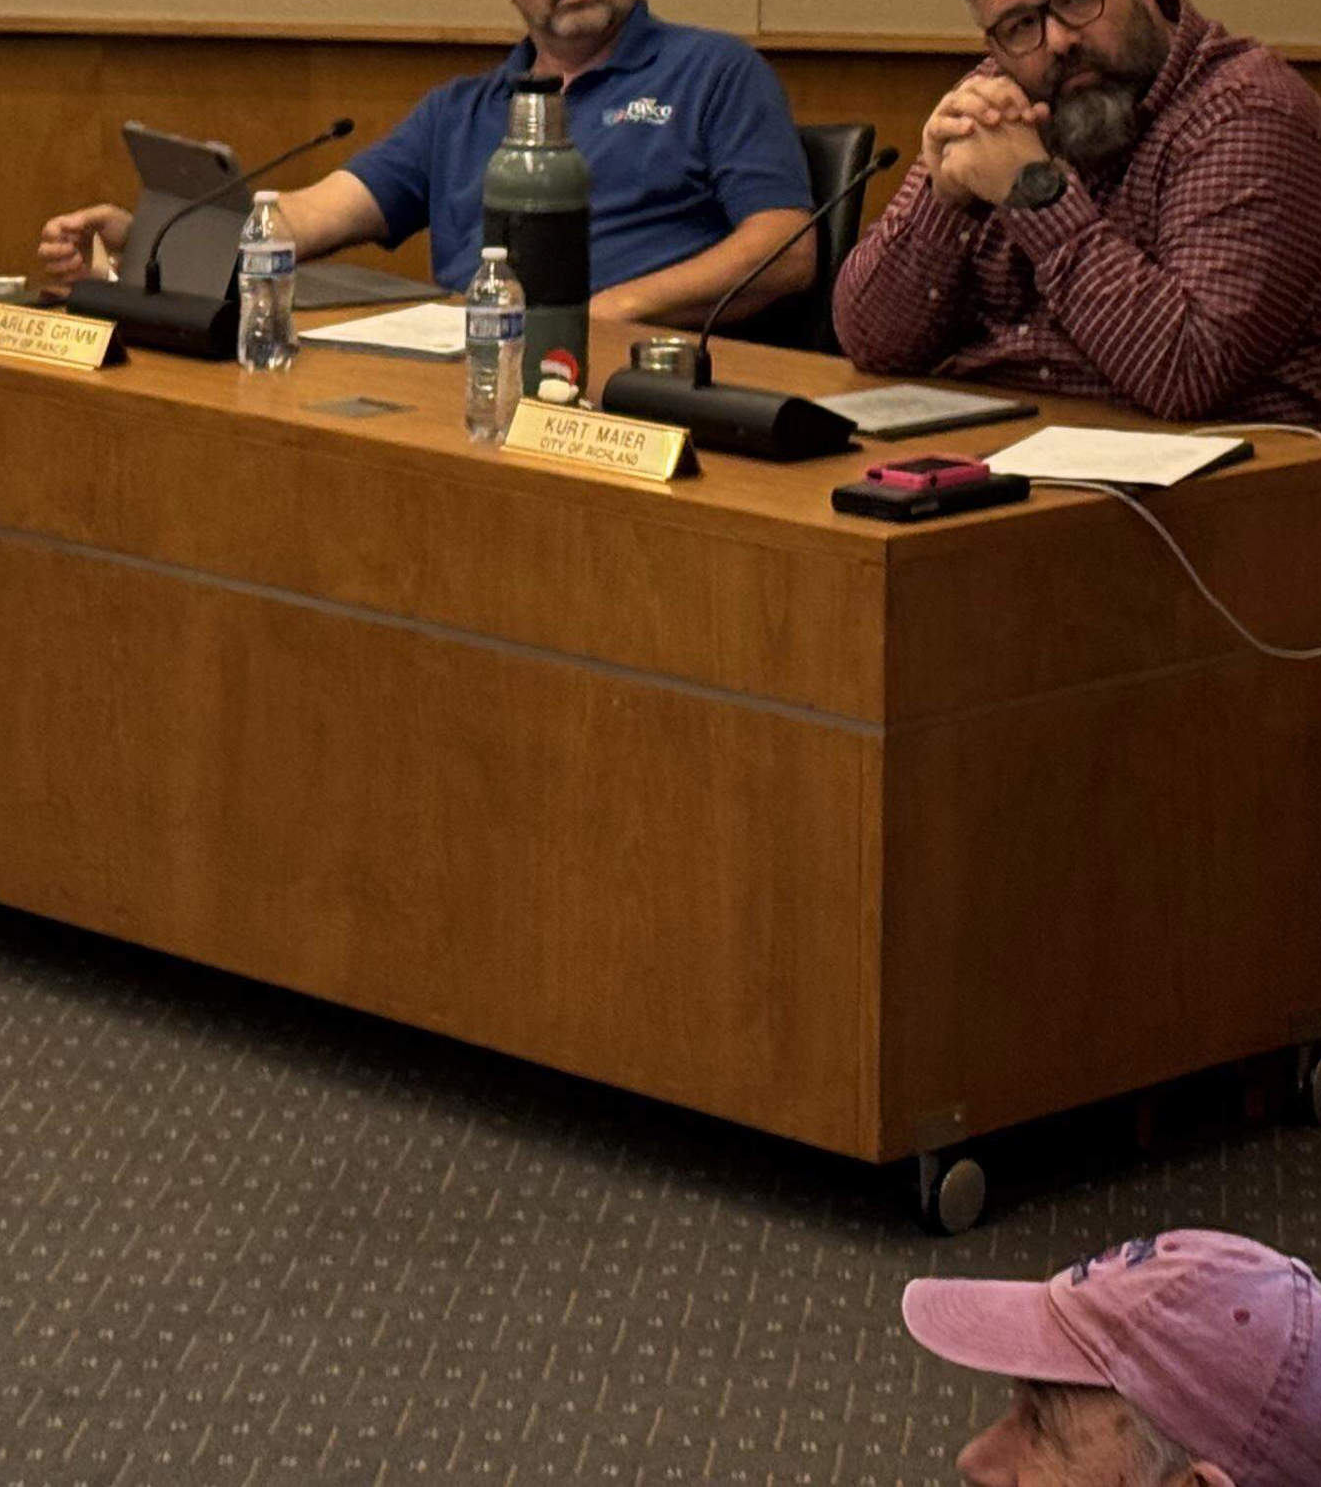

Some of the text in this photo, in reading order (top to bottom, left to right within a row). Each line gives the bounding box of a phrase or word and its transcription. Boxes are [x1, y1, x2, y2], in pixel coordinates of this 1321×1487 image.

[50, 324, 99, 346] GRIMM
[544, 416, 647, 451] KURT MAIER
[540, 436, 639, 466] CITY OF RICHLAND
